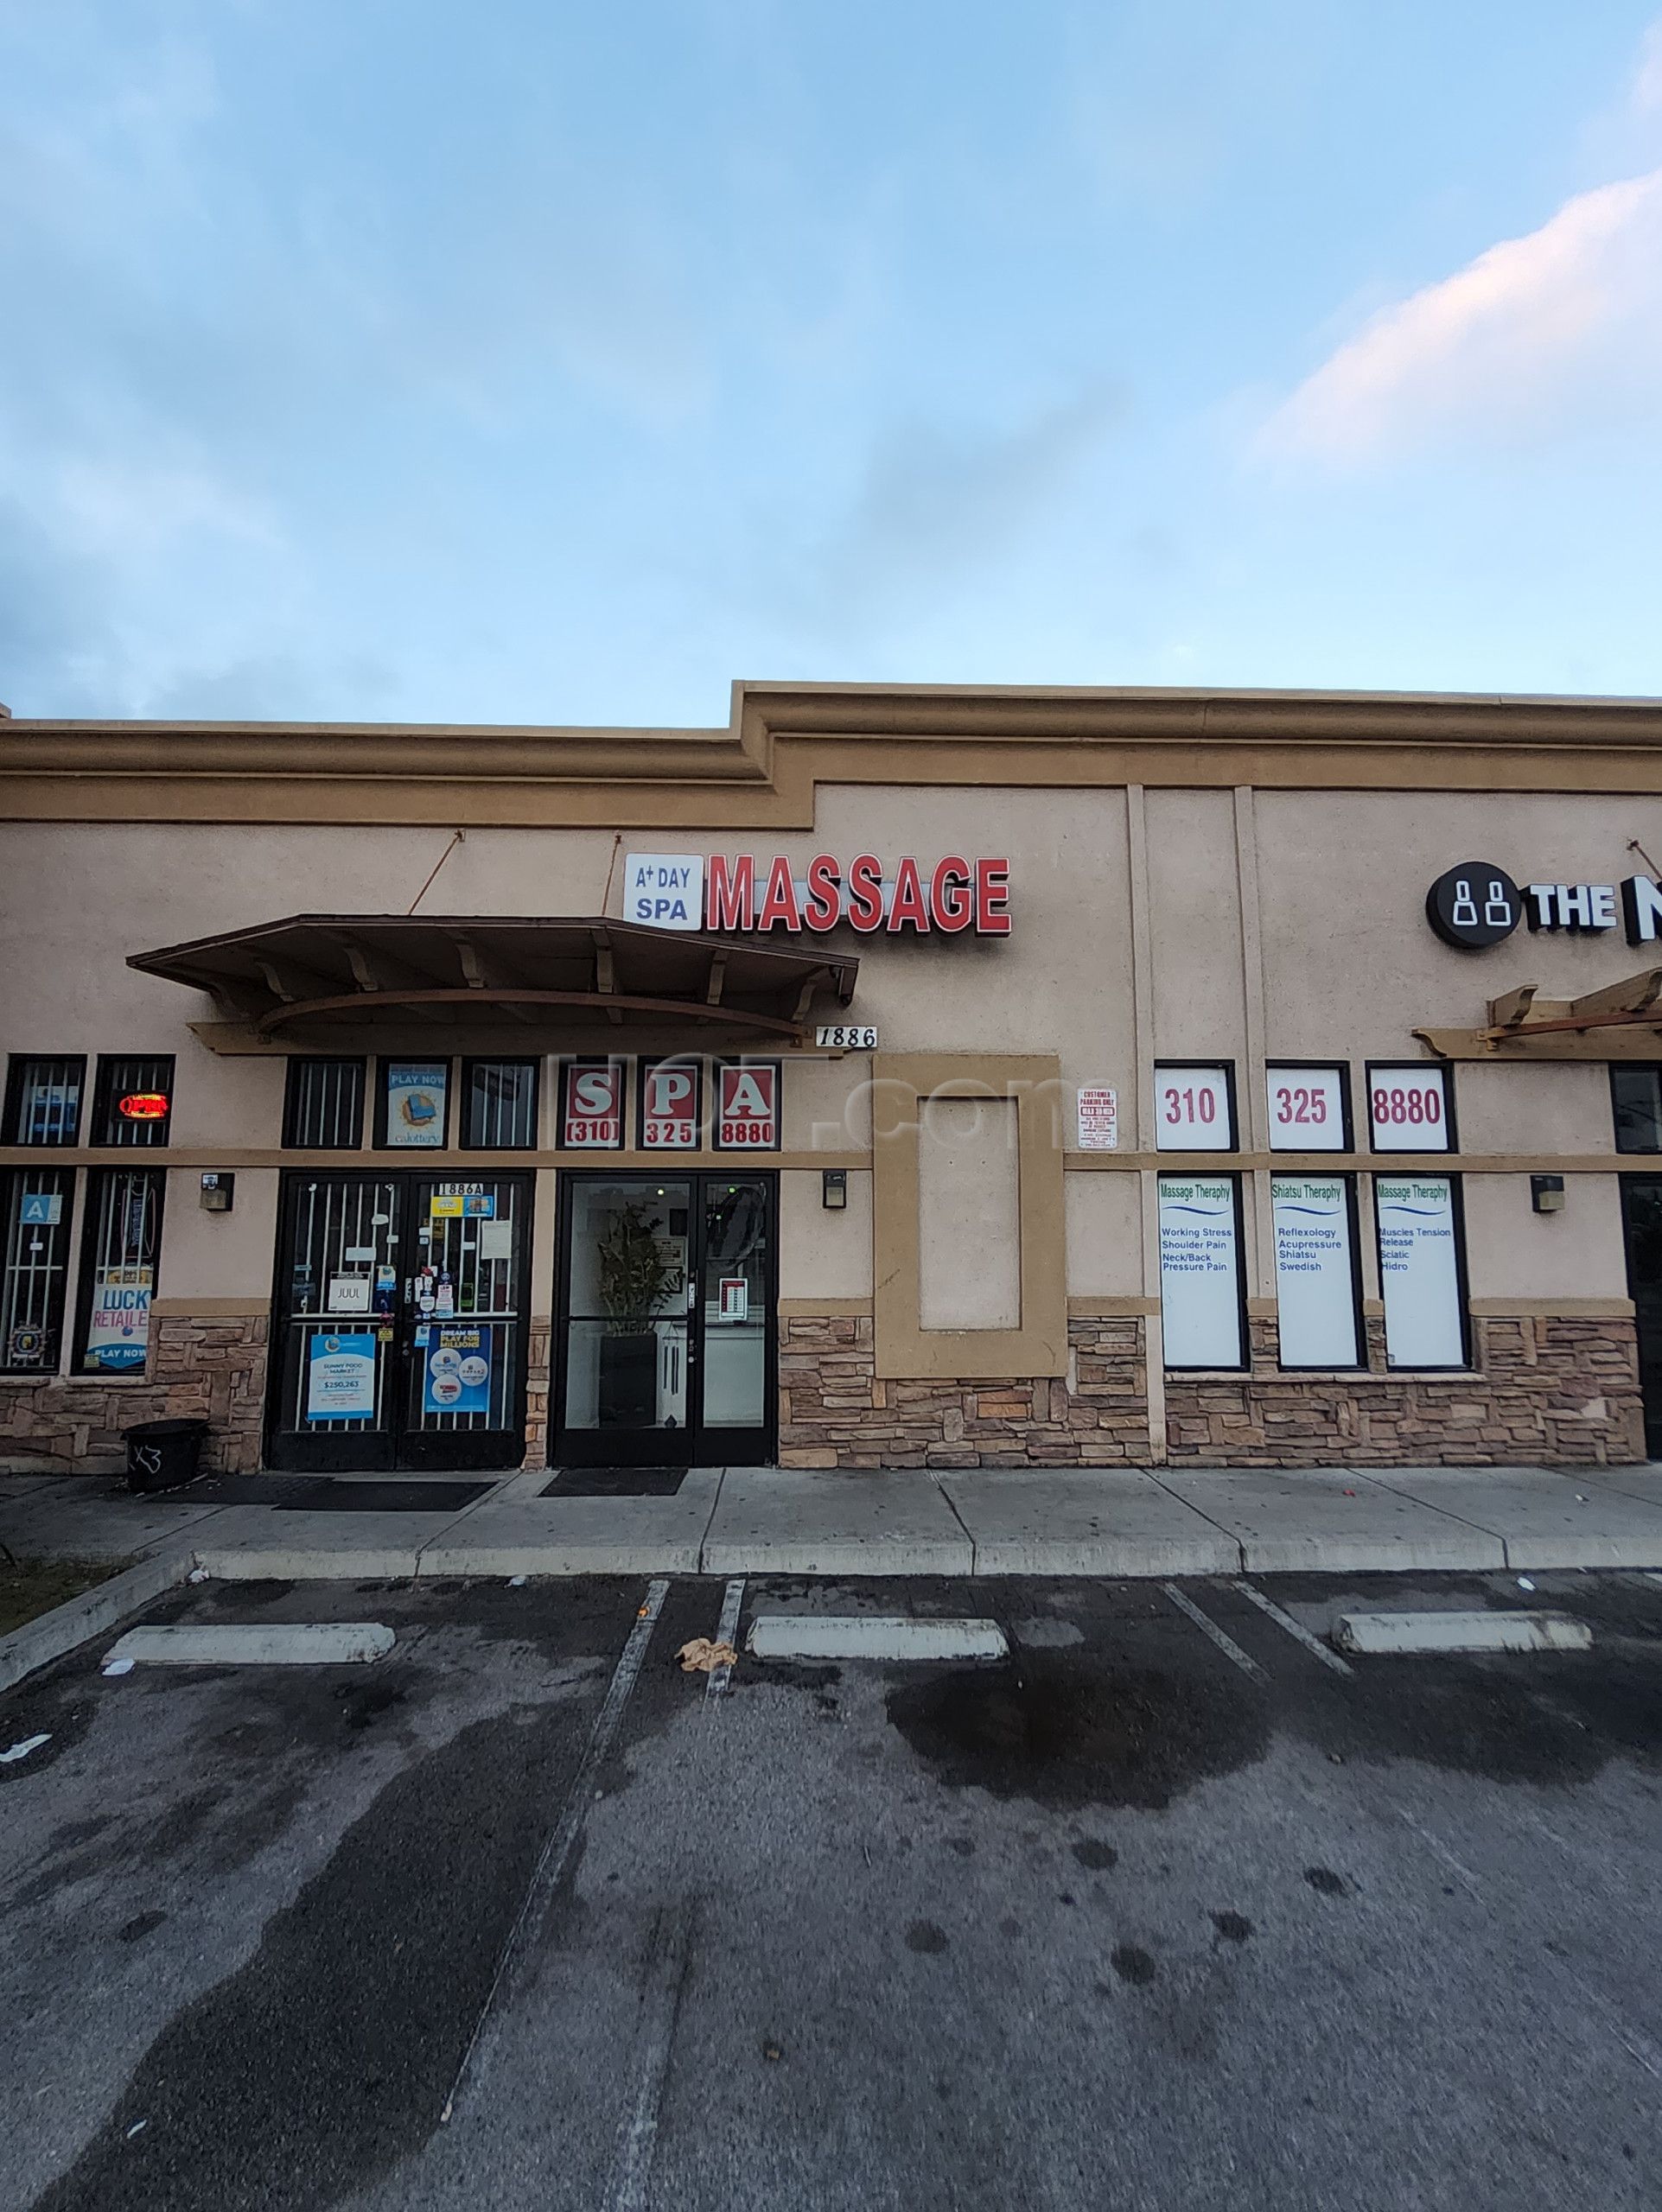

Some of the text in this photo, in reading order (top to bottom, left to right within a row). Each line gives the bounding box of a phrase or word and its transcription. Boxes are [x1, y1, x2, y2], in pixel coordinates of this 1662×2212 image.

[635, 865, 691, 888] A+ DAY
[706, 853, 1012, 933] MASSAGE
[635, 897, 688, 921] SPA
[1528, 884, 1618, 928] THE
[820, 1027, 876, 1047] 1886
[391, 1074, 418, 1084] PLAY
[1165, 1087, 1215, 1124] 310
[1277, 1087, 1327, 1124] 325
[1373, 1088, 1441, 1125] 8880
[566, 1121, 621, 1142] (310)
[646, 1122, 692, 1144] 325
[722, 1122, 774, 1143] 8880
[442, 1183, 483, 1195] 1886A
[1161, 1184, 1230, 1202] Massage Theraphy
[1271, 1184, 1340, 1202] Shiatsu Theraphy
[1378, 1184, 1448, 1202] Massage Theraphy
[27, 1200, 43, 1219] A
[1162, 1228, 1232, 1238] Working Stress
[1278, 1228, 1336, 1238] Reflexology
[1416, 1228, 1451, 1236] Tension
[1162, 1240, 1226, 1249] Shoulder Pain
[1279, 1240, 1342, 1249] Acupressure
[1381, 1237, 1414, 1246] Release
[1162, 1253, 1212, 1262] Neck/Back
[1279, 1249, 1316, 1259] Shiatsu
[1381, 1249, 1410, 1259] Sciatic
[1162, 1262, 1227, 1271] Pressure Pain
[1279, 1262, 1321, 1271] Swedish
[1382, 1262, 1409, 1271] Hidro
[104, 1289, 152, 1311] LUCK
[338, 1287, 360, 1299] JUUL
[95, 1350, 121, 1358] PLAY
